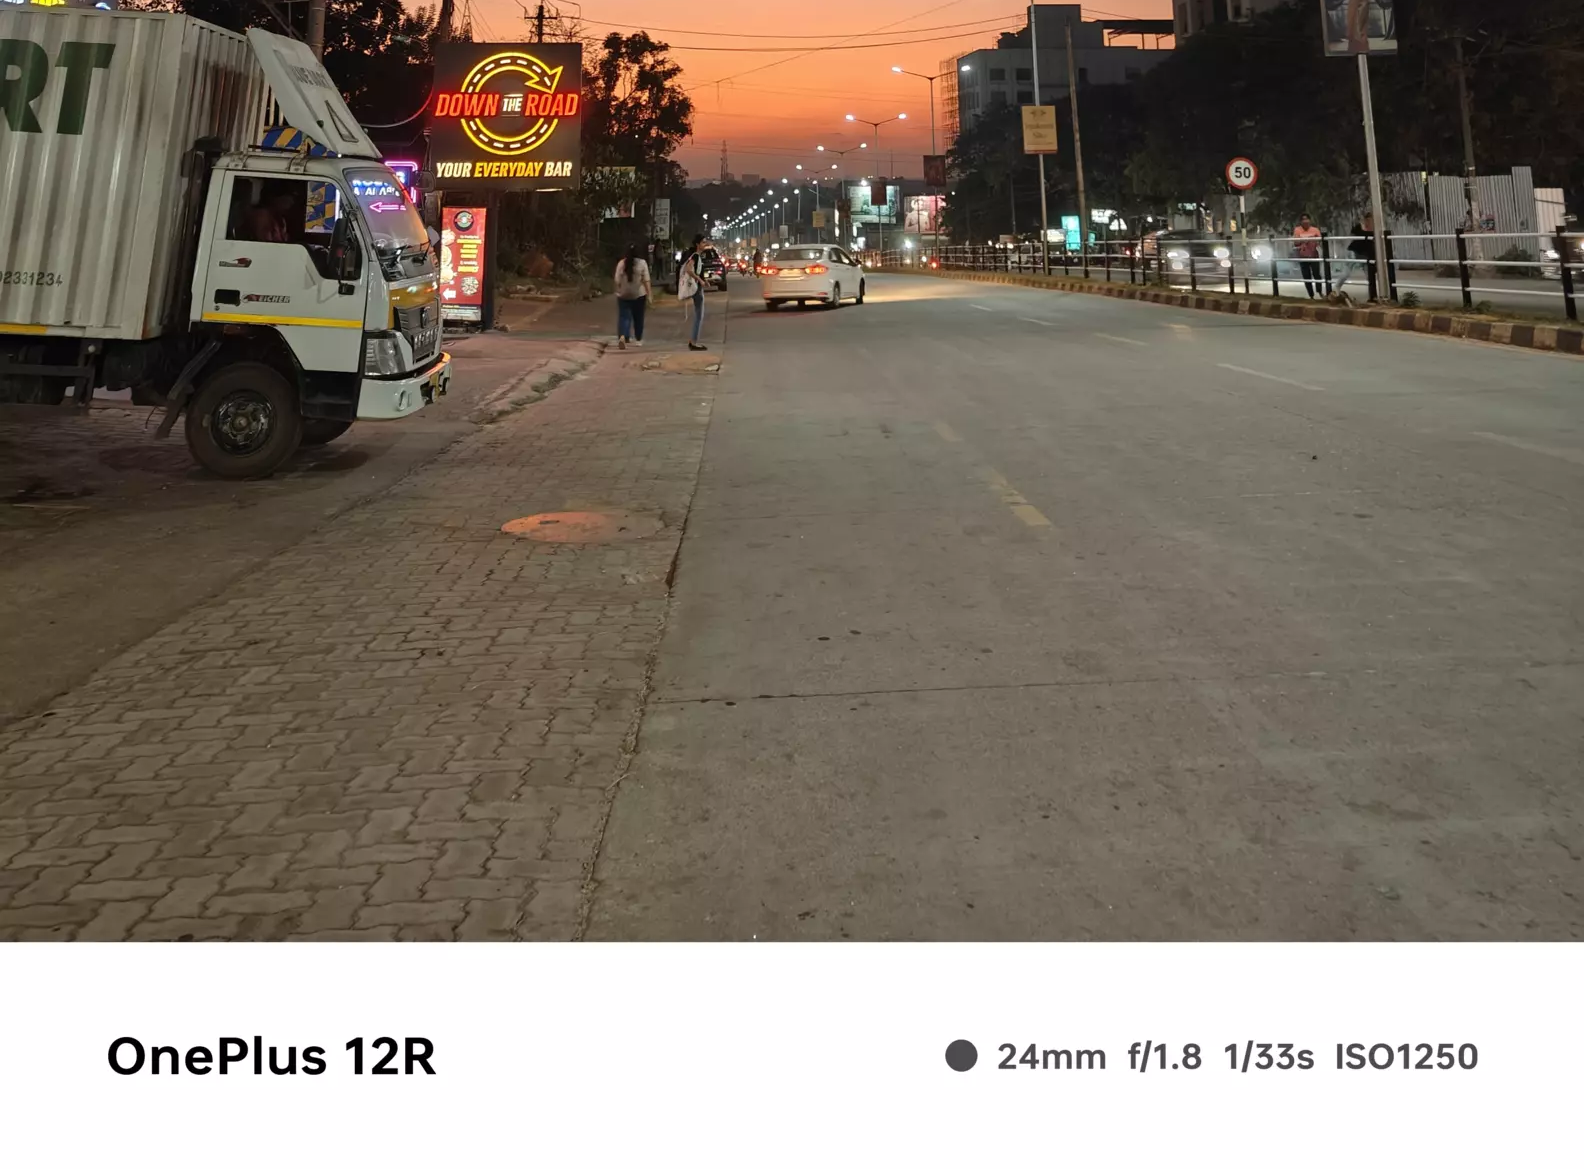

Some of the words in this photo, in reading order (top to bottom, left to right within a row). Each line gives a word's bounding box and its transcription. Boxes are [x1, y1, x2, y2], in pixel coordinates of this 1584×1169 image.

[435, 93, 499, 116] DOWN
[502, 98, 523, 112] THE
[525, 93, 579, 116] ROAD
[436, 162, 473, 178] YOUR
[474, 161, 544, 177] EVERYDAY
[544, 161, 573, 177] BAR
[1234, 166, 1252, 179] 50
